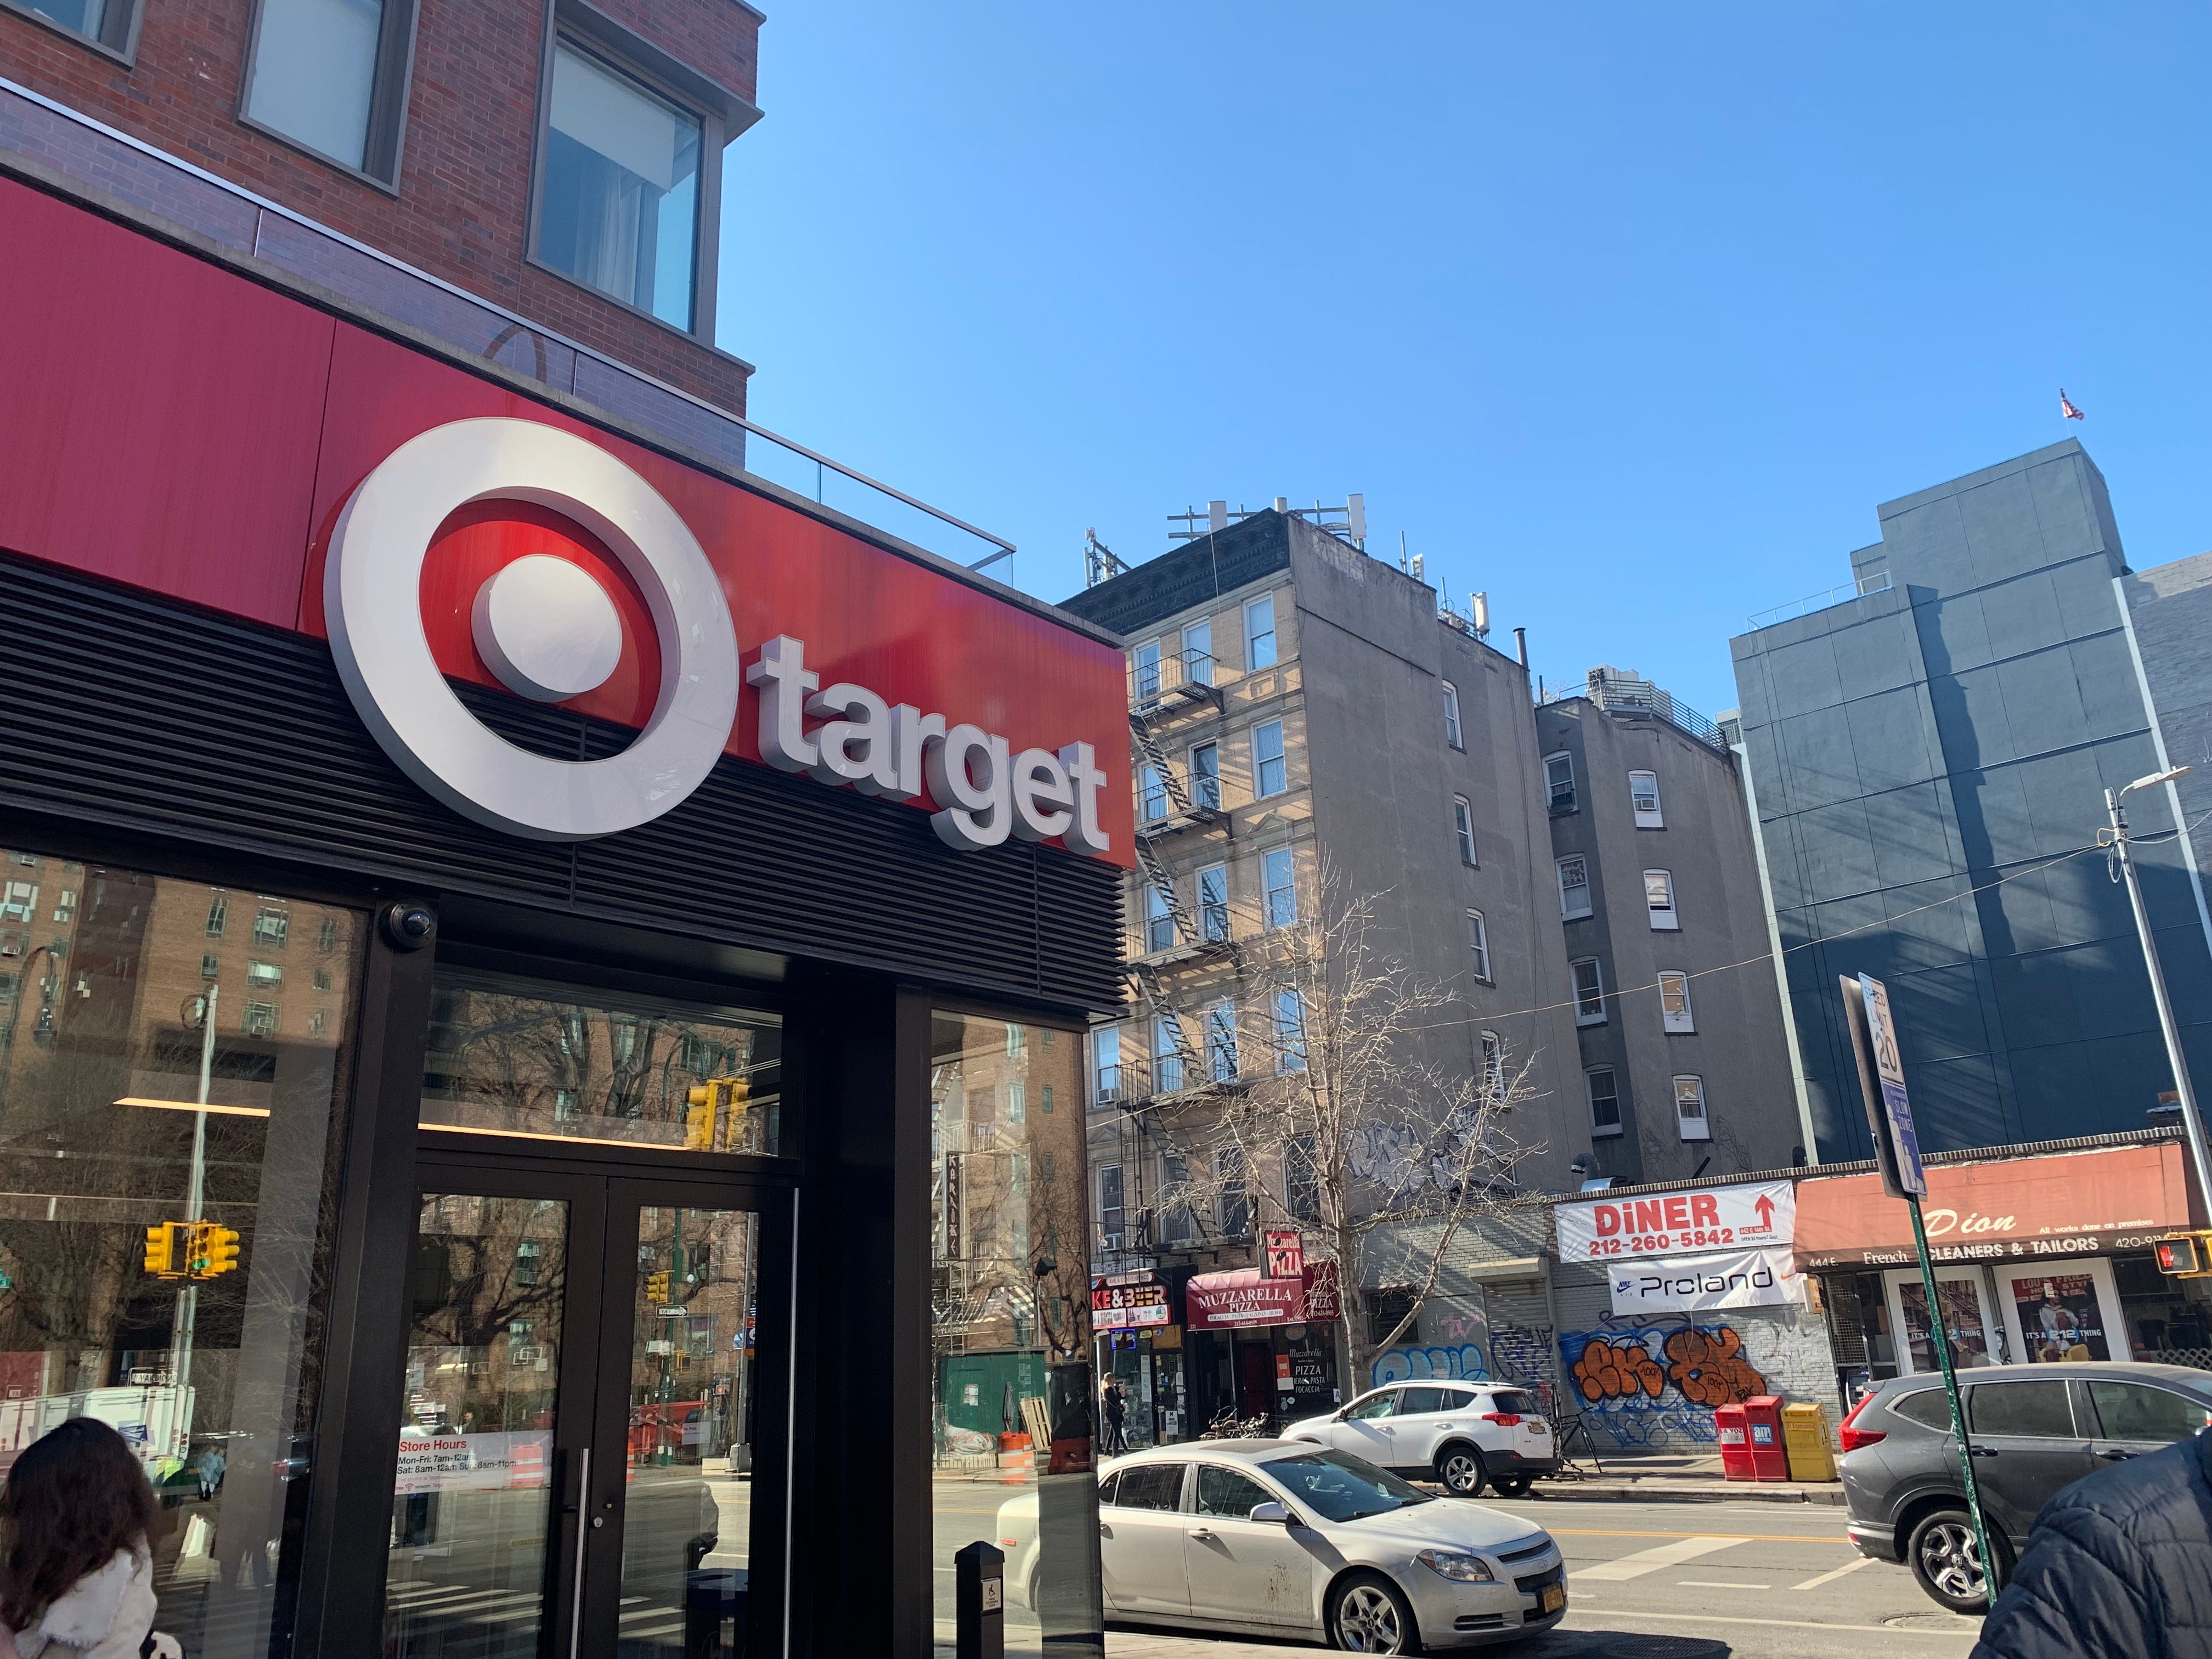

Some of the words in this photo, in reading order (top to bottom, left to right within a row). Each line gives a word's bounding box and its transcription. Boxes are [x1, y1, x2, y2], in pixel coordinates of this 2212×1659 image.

[747, 634, 1109, 853] target
[1864, 986, 1886, 1007] SPEED
[1870, 1008, 1887, 1028] LIMIT
[1876, 1031, 1898, 1073] 20
[1895, 1099, 1909, 1115] SLOW
[1898, 1115, 1912, 1132] ZONE
[1922, 1209, 2017, 1237] Dion
[2055, 1225, 2079, 1234] works
[2083, 1222, 2101, 1231] done
[2118, 1218, 2154, 1229] premises
[1267, 1234, 1300, 1249] Muzarella
[1589, 1228, 1734, 1256] 212-260-5842
[1809, 1258, 1829, 1267] 444
[1862, 1250, 1909, 1265] French
[1928, 1243, 2004, 1261] CLEANERS
[2011, 1242, 2023, 1256] &
[2030, 1237, 2099, 1254] TAILORS
[1268, 1251, 1303, 1276] PIZZA
[1640, 1266, 1773, 1297] Proland
[1198, 1288, 1293, 1309] MUZZARELLA
[1229, 1301, 1261, 1313] PIZZA
[2026, 1331, 2040, 1340] IT'S
[2079, 1329, 2102, 1337] THING
[1289, 1348, 1322, 1358] Muzzarella
[1295, 1365, 1321, 1375] PIZZA
[1310, 1376, 1325, 1384] PASTA
[1295, 1385, 1320, 1393] FOCACCIA
[1335, 1390, 1341, 1399] A
[1753, 1426, 1771, 1438] am
[399, 1441, 430, 1452] Store
[433, 1440, 467, 1451] Hours
[397, 1466, 413, 1475] Sat:
[415, 1463, 457, 1473] 8am-12am
[477, 1460, 517, 1471] 8am-11pm
[398, 1455, 432, 1465] Mon-Fri:
